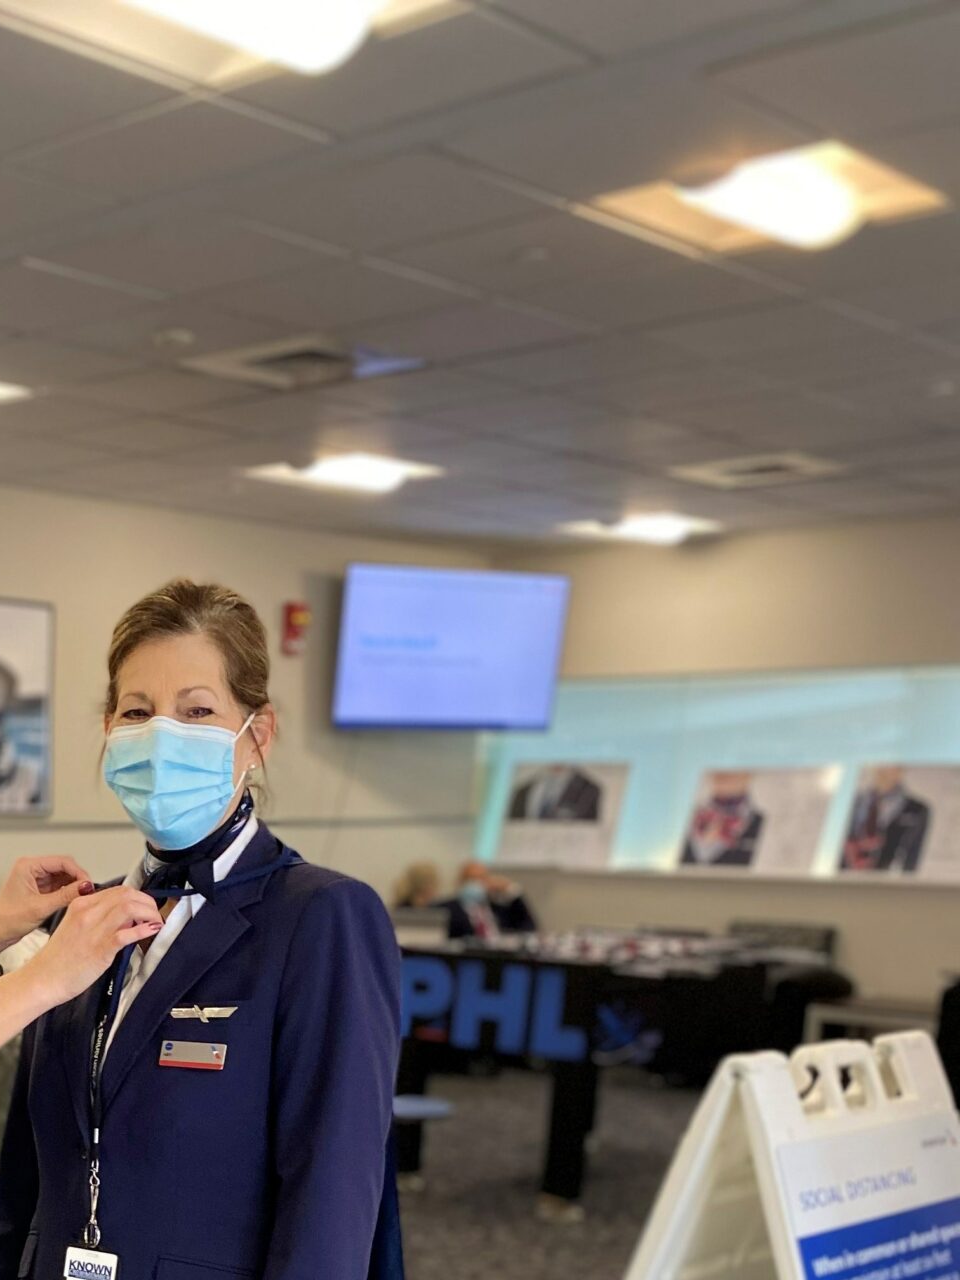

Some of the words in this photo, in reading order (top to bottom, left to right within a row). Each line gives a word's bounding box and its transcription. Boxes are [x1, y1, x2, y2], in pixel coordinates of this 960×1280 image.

[401, 957, 587, 1061] PHL
[800, 1185, 843, 1211] SOCIAL
[846, 1167, 916, 1199] DISTANCING
[69, 1259, 113, 1277] KNOWN
